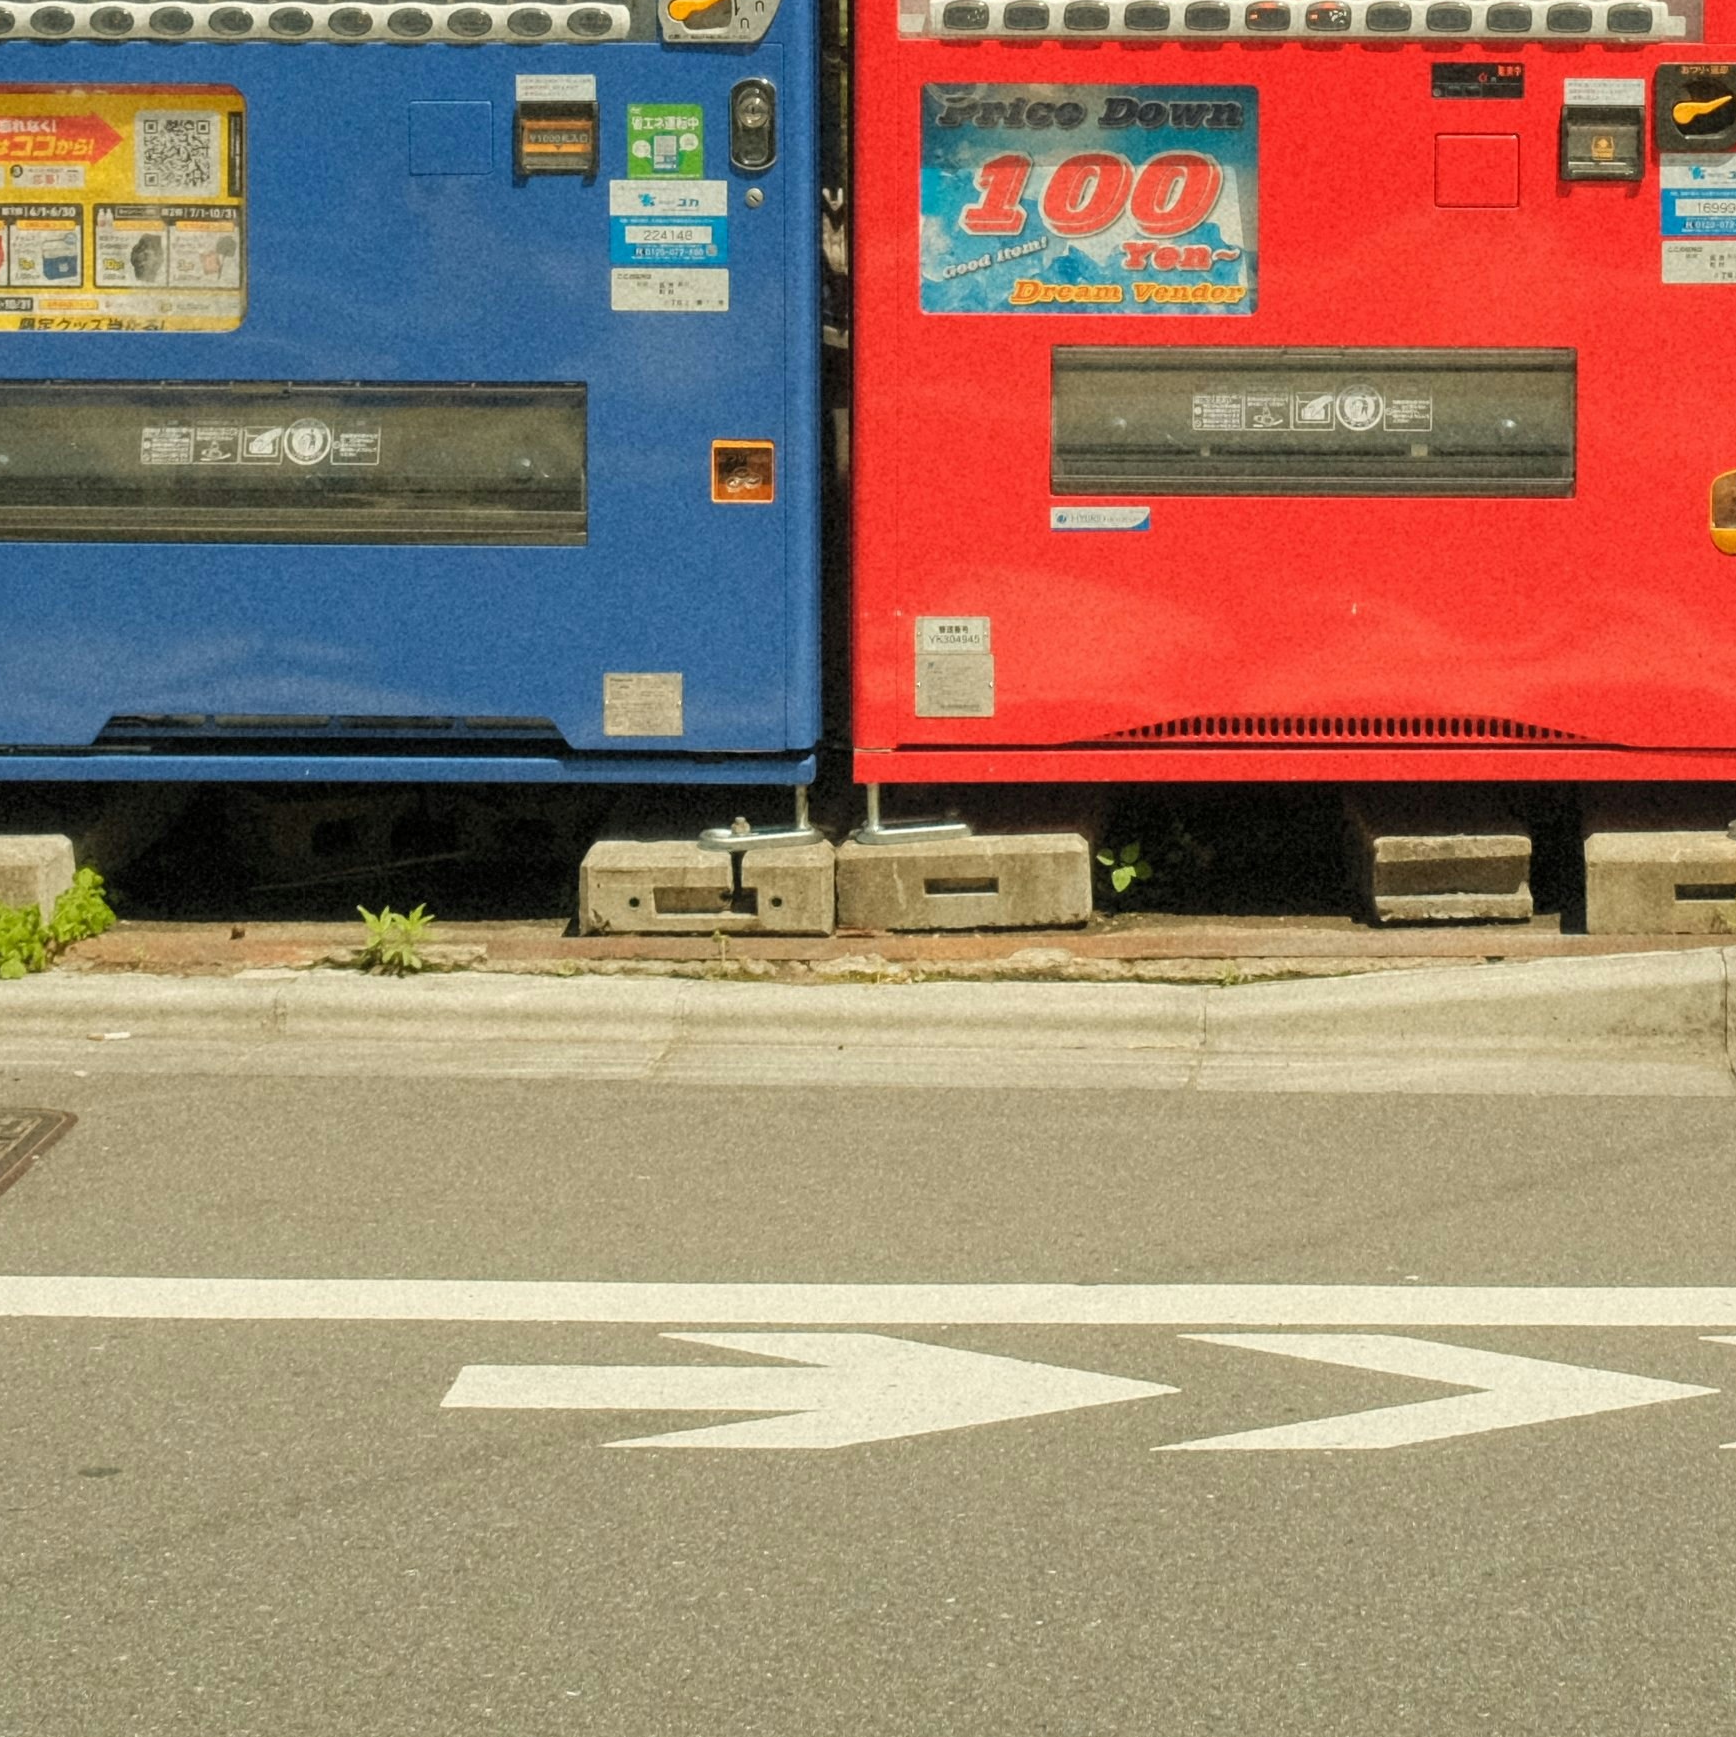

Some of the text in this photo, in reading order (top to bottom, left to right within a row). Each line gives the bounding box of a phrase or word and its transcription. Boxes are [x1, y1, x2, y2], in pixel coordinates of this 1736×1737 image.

[631, 116, 700, 131] 省エネ運転中
[935, 95, 1243, 130] Price Down
[958, 150, 1224, 238] 100
[942, 253, 993, 280] Good
[1008, 280, 1122, 305] Dream
